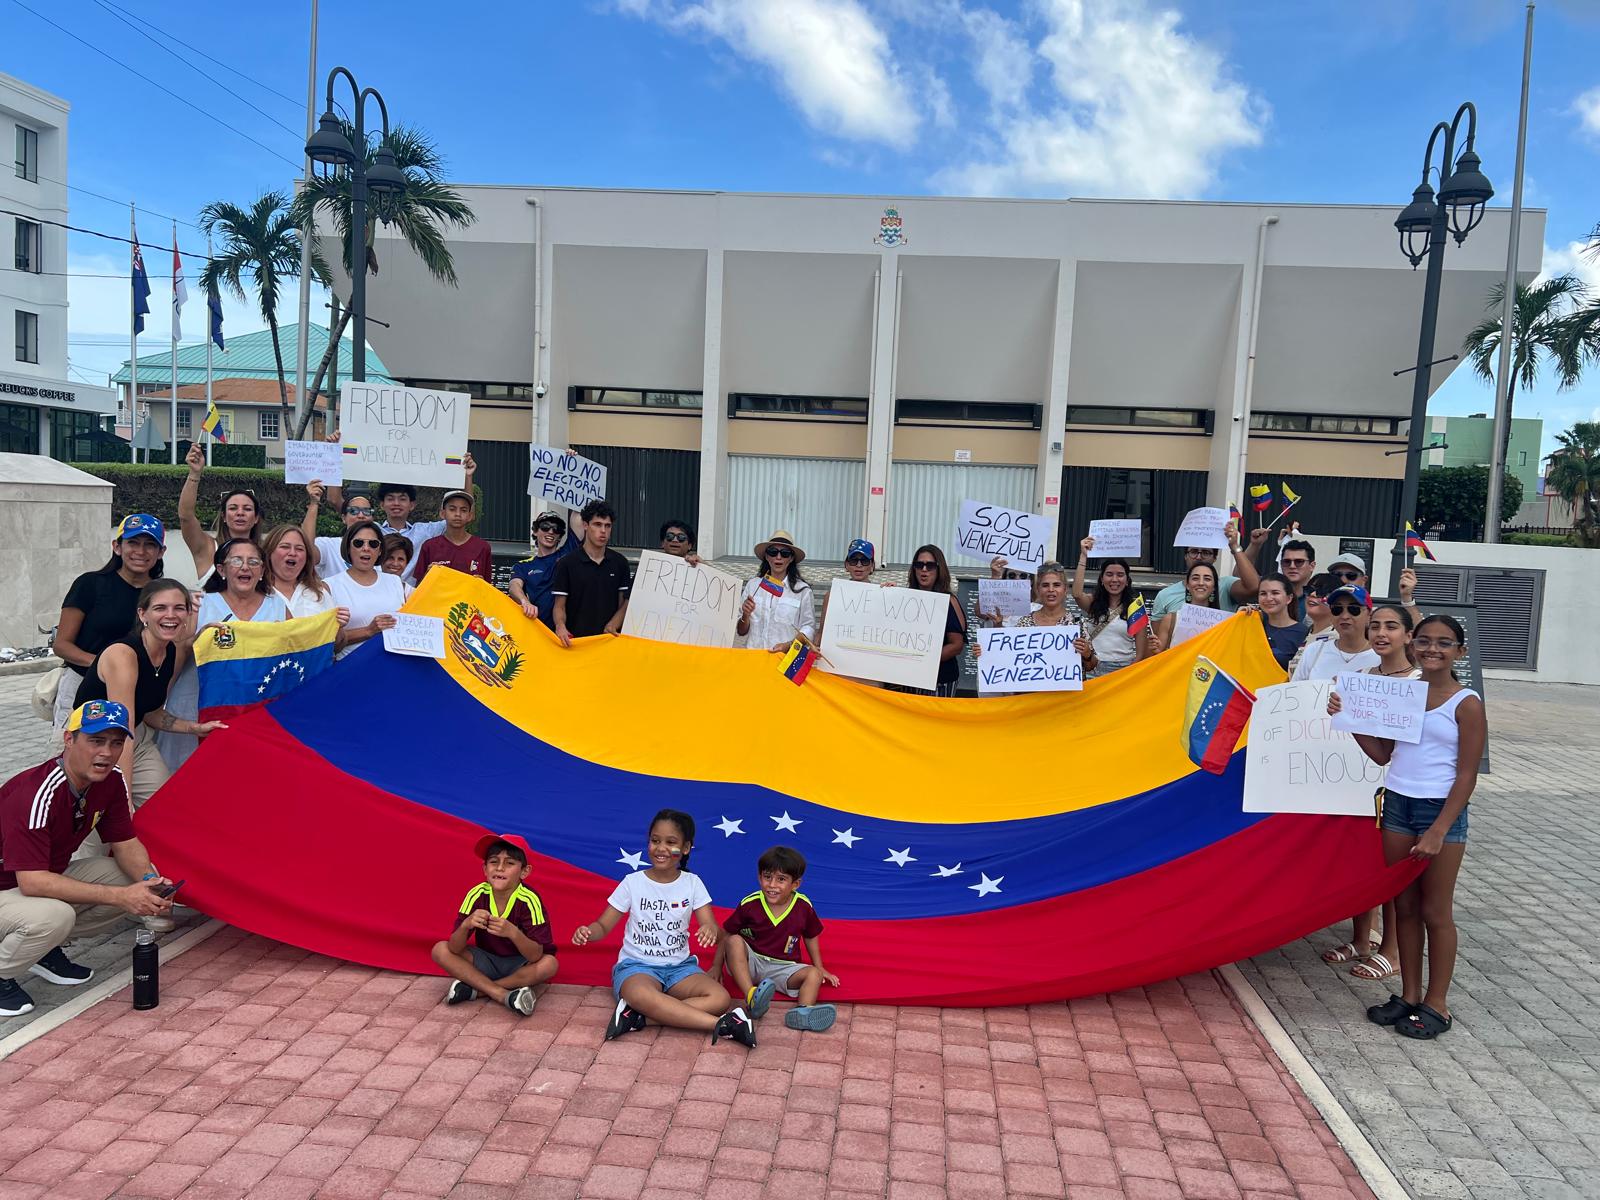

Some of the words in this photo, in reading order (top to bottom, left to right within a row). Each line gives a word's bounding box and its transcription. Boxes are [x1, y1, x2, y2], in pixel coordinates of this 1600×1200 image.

[39, 388, 76, 402] COFFEE
[349, 387, 456, 434] FREEDOM
[388, 428, 411, 441] FOR
[359, 444, 438, 466] VENEZUELA
[532, 449, 553, 465] NO
[557, 455, 578, 472] NO
[580, 462, 602, 483] NO
[533, 467, 605, 500] ELECTORAL
[957, 527, 1045, 565] VENEZUELA
[641, 557, 736, 620] FREEDOM
[674, 601, 699, 616] FOR
[840, 586, 873, 615] WE
[882, 590, 937, 625] WON
[1187, 605, 1223, 622] MADURO
[396, 614, 434, 629] NEZUELA
[1181, 617, 1191, 625] WE
[835, 624, 856, 640] THE
[987, 632, 1077, 654] FREEDOM
[1014, 652, 1048, 666] FOR
[981, 664, 1082, 686] VENEZUELA
[1341, 676, 1415, 698] VENEZUELA
[1269, 685, 1300, 715] 25
[1348, 695, 1390, 710] NEEDS
[1351, 709, 1378, 720] YOUR
[1382, 712, 1413, 728] HELP!
[1263, 726, 1283, 743] OF
[640, 897, 670, 912] HASTA
[655, 912, 666, 921] EL
